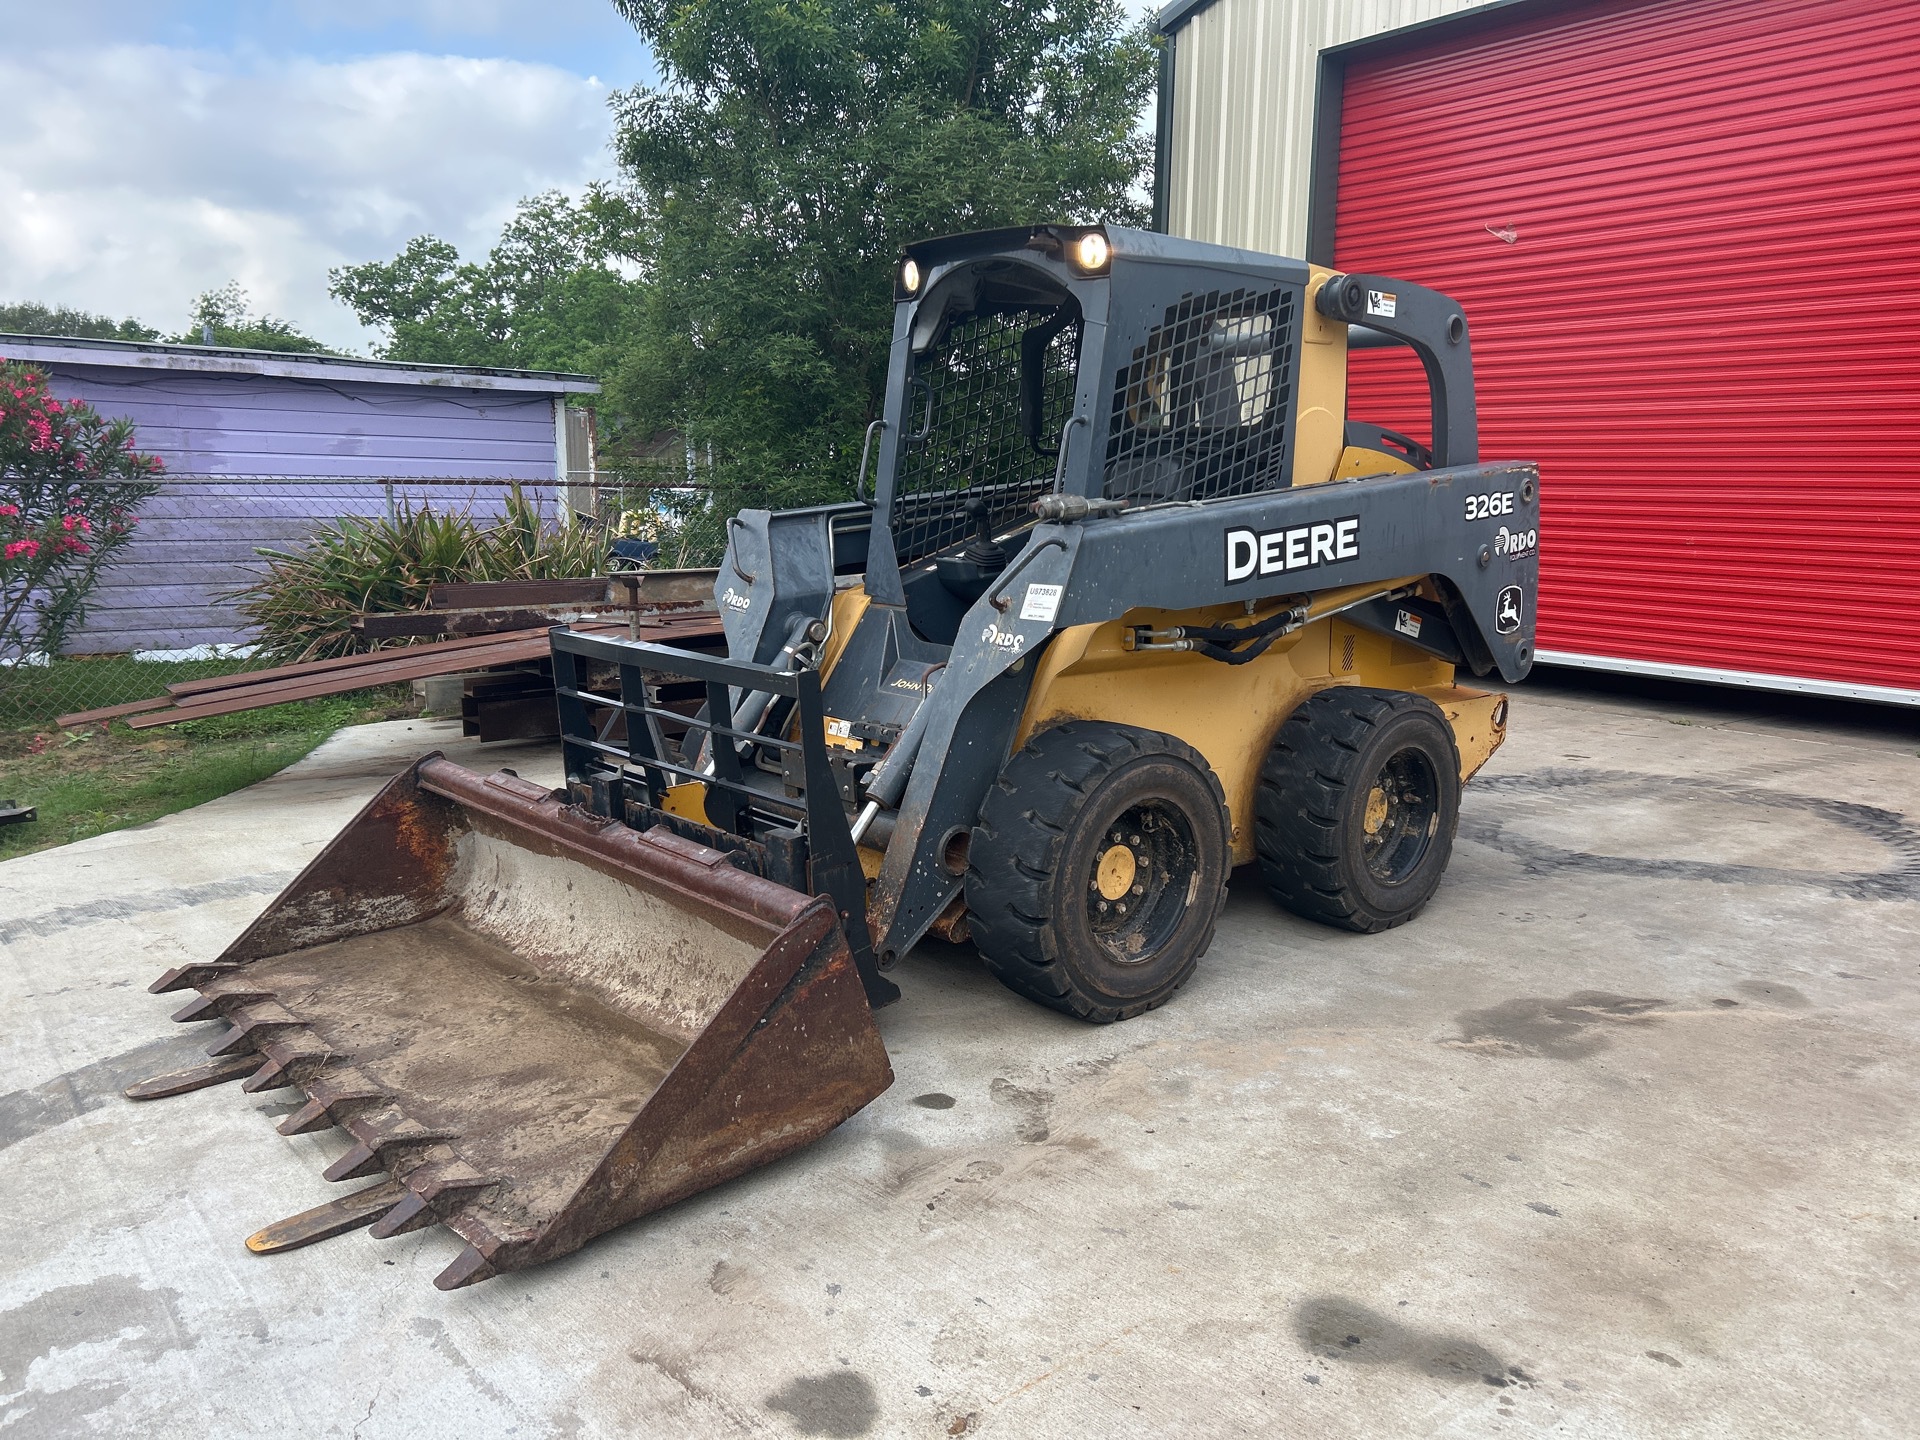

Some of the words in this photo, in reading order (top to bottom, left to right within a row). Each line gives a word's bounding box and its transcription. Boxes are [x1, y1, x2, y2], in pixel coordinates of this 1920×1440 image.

[1465, 492, 1514, 520] 326E
[1227, 518, 1358, 581] DEERE
[890, 679, 922, 691] JOHN
